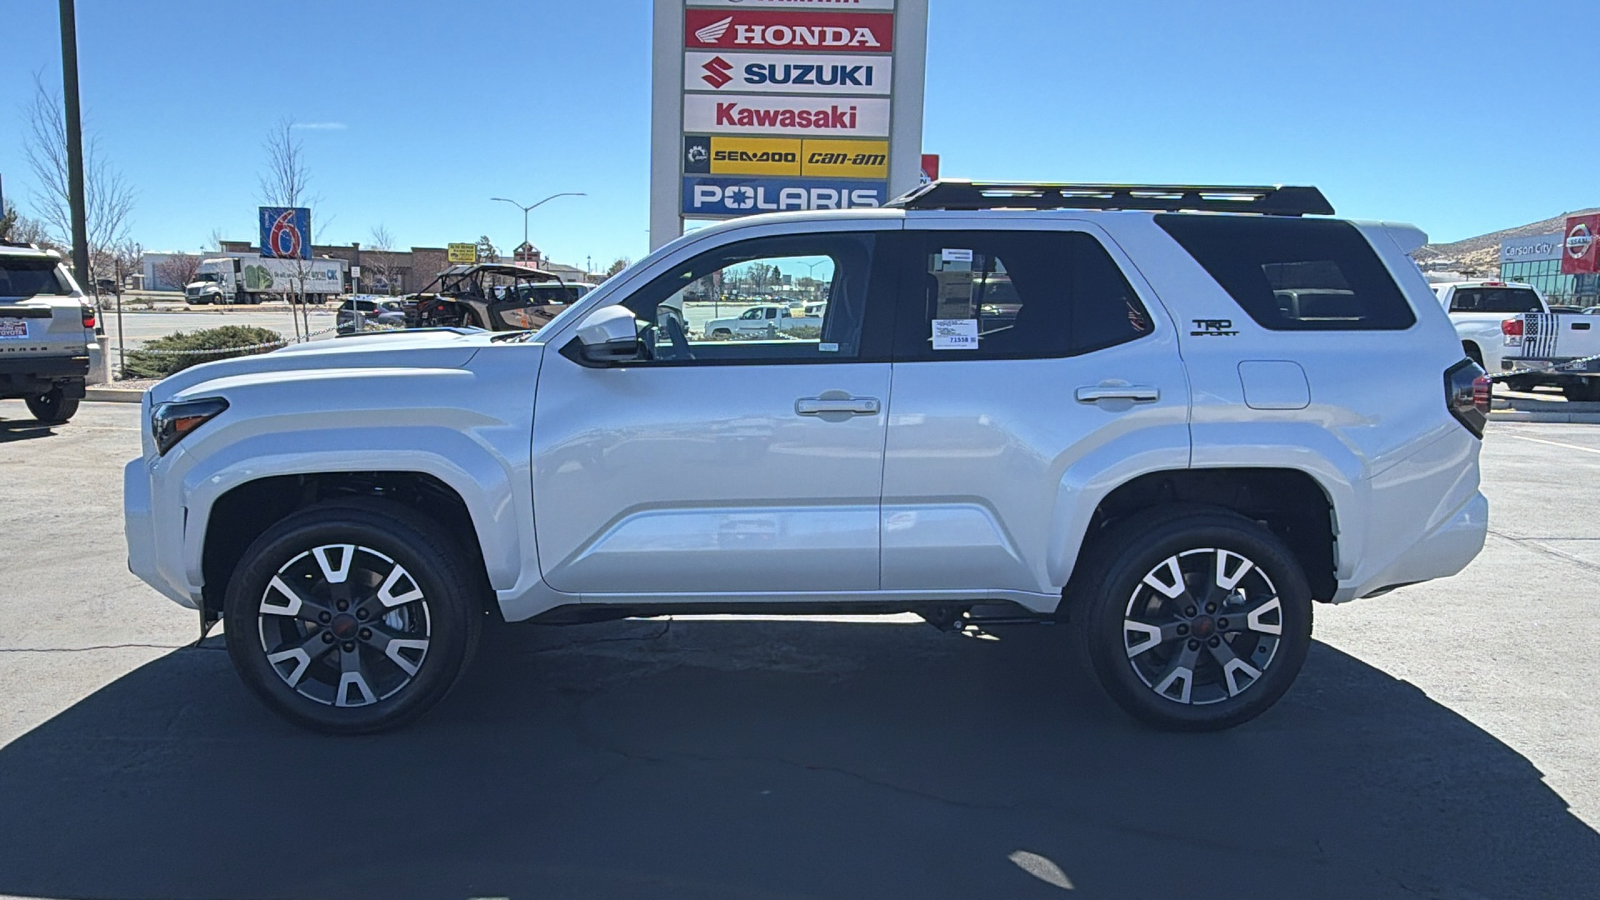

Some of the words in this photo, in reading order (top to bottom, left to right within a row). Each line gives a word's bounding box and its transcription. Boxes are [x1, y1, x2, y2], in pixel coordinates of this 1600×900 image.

[734, 24, 881, 47] HONDA
[744, 63, 873, 86] SUZUKI
[716, 102, 857, 129] Kawasaki
[693, 184, 879, 210] POLARIS
[270, 210, 302, 258] 6
[1505, 246, 1534, 256] Carson
[1535, 242, 1553, 255] City
[1192, 319, 1232, 331] TRD
